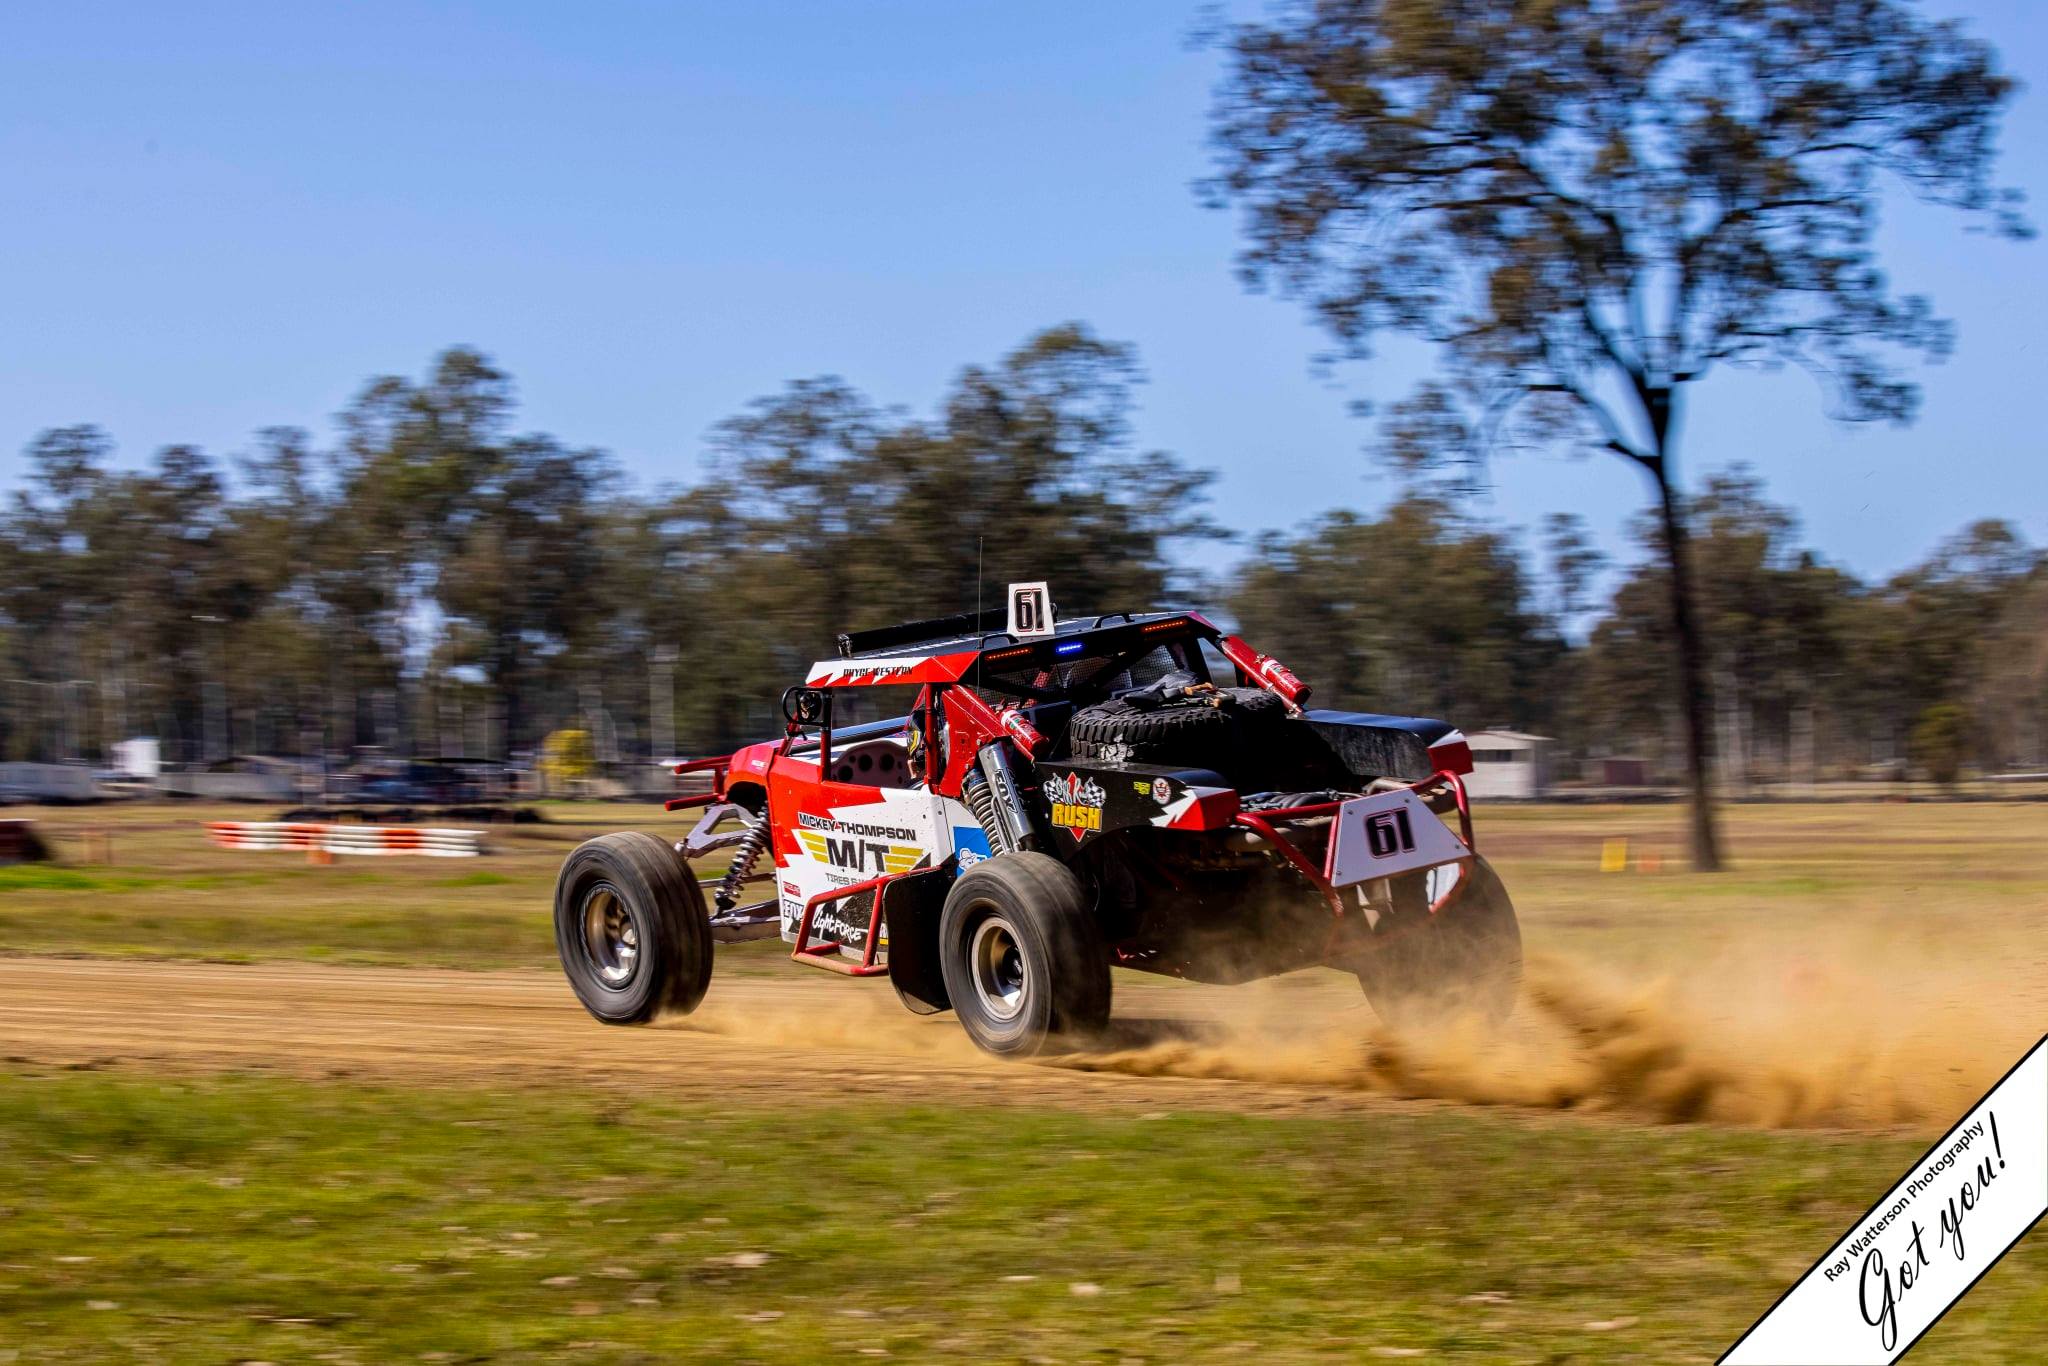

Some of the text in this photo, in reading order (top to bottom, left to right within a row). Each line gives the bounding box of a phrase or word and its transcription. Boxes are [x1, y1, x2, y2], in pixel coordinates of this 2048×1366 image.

[1013, 588, 1045, 632] 61
[799, 813, 917, 841] MICKEY THOMPSON
[1052, 802, 1102, 831] RUSH
[1364, 807, 1416, 859] 61
[825, 872, 850, 886] TIRES
